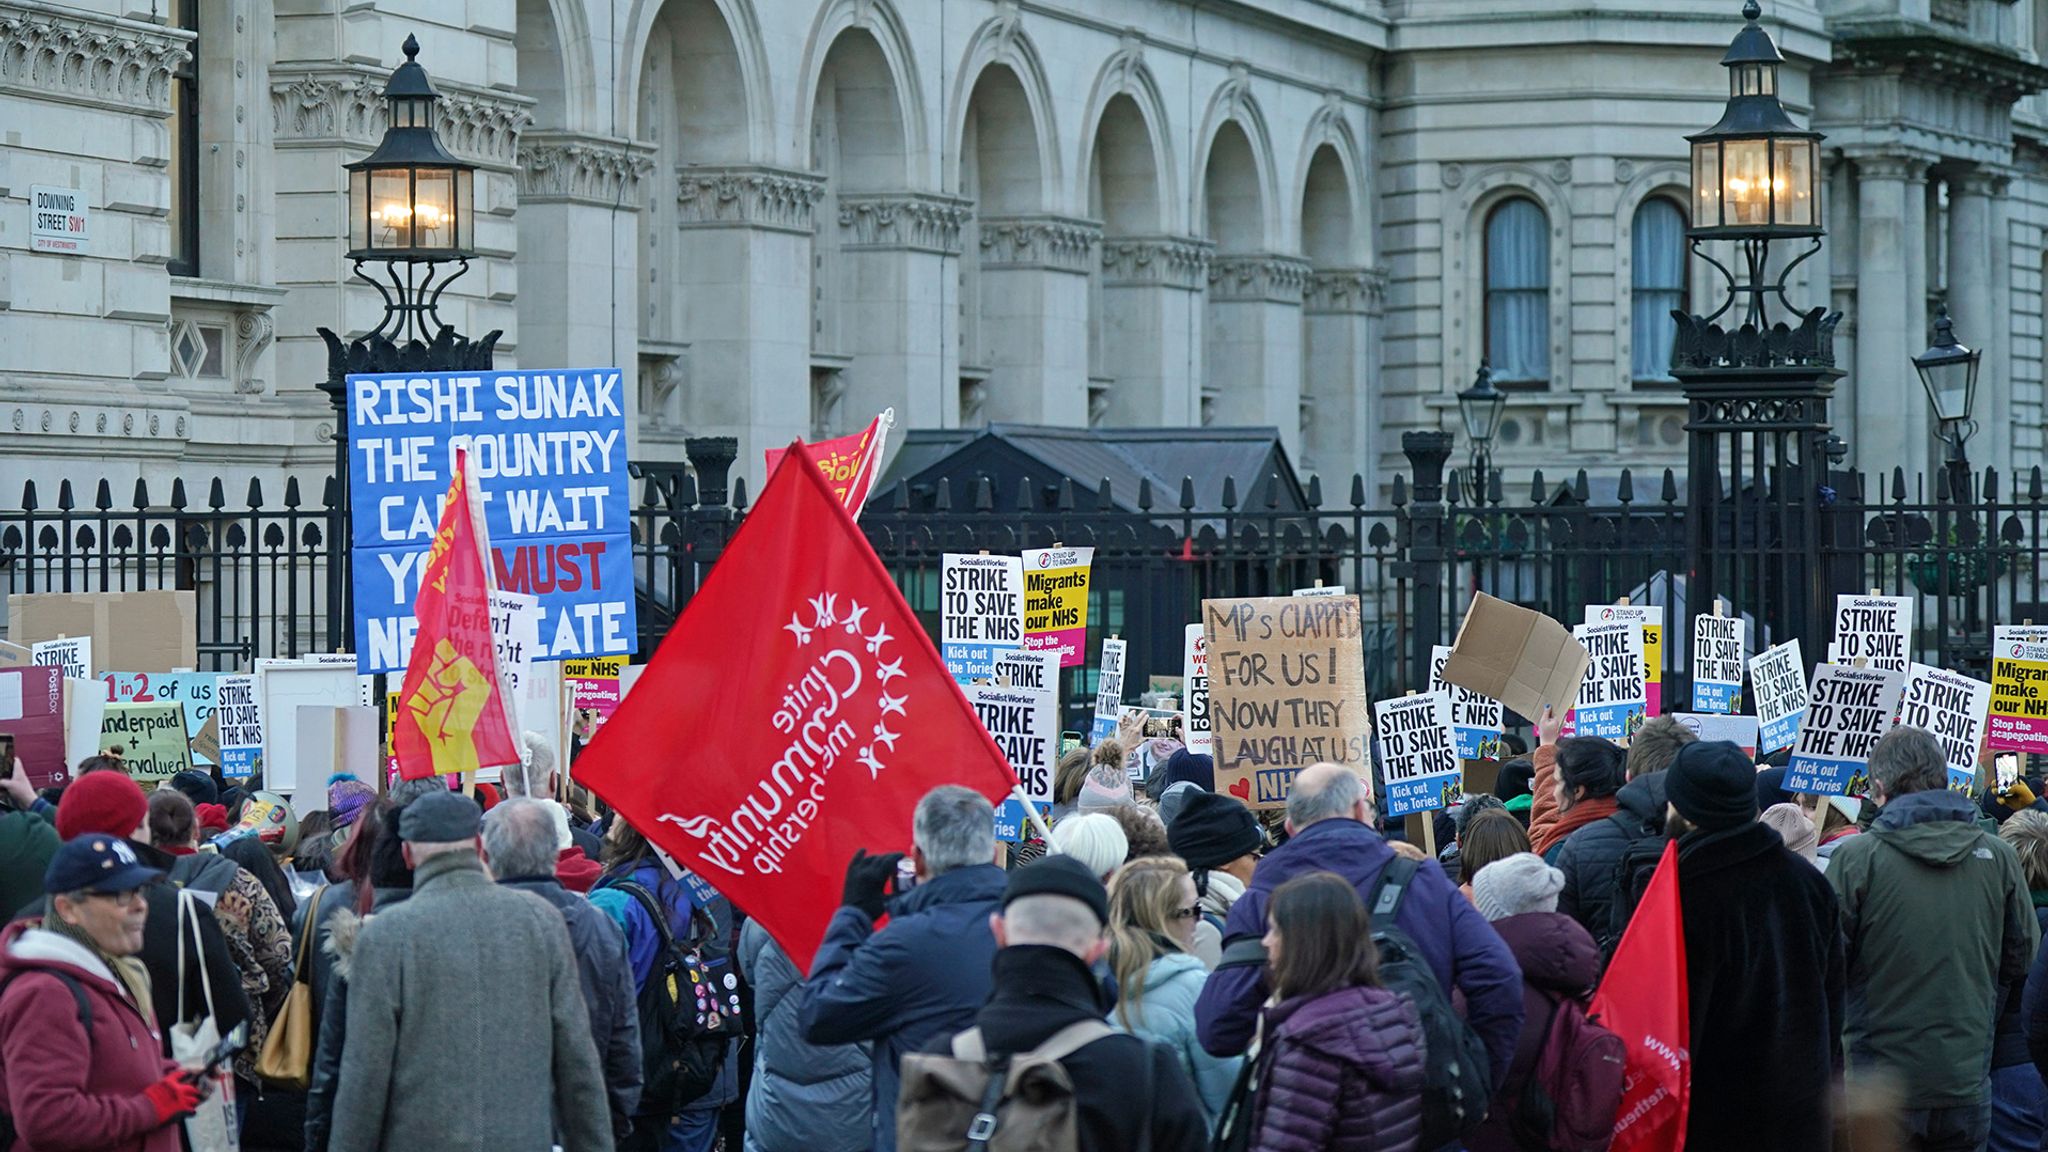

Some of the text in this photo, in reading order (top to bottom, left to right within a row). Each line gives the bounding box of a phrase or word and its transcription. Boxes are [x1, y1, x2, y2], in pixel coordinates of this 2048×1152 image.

[38, 192, 74, 212] DOWNING
[38, 213, 85, 232] STREET SW1
[354, 374, 621, 426] RISHI SUNAK
[357, 436, 437, 484] THE
[506, 486, 609, 534] WAIT
[491, 541, 606, 595] MUST
[960, 558, 1008, 567] Socialist Worker
[946, 567, 1008, 592] STRIKE
[1027, 571, 1086, 594] Migrants
[946, 592, 1017, 616] TO SAVE
[1026, 595, 1063, 612] make
[1876, 600, 1897, 608] Worker
[946, 616, 1020, 641] THE NHS
[1026, 608, 1078, 630] our NHS
[1608, 624, 1628, 632] Worker
[1698, 617, 1736, 640] STRIKE
[1840, 608, 1896, 633] STRIKE
[1024, 635, 1058, 648] Stop the
[1696, 638, 1740, 661] TO SAVE
[1838, 633, 1904, 658] TO SAVE
[35, 648, 78, 666] STRIKE
[948, 646, 988, 660] Kick out
[1006, 652, 1024, 661] Socialist
[565, 662, 620, 676] our NHS
[948, 661, 993, 674] the Tories
[995, 662, 1044, 688] STRIKE
[1220, 651, 1274, 687] FOR
[1601, 654, 1638, 678] SAVE
[1696, 659, 1741, 682] THE NHS
[1753, 654, 1792, 686] STRIKE
[1834, 670, 1886, 682] Socialist Worker
[1997, 662, 2048, 682] Migran
[104, 673, 212, 702] 1 in 2 of us
[584, 681, 598, 690] the
[1580, 677, 1641, 704] THE NHS
[1696, 684, 1723, 698] Kick out
[1756, 670, 1801, 704] TO SAVE
[1928, 670, 1975, 691] Socialist Worker
[1995, 683, 2038, 698] make
[219, 686, 252, 706] STRIKE
[576, 690, 618, 702] pegoating
[978, 691, 1036, 704] Socialist Worker
[1390, 697, 1434, 710] Socialist Worker
[1813, 678, 1883, 708] STRIKE
[1910, 678, 1974, 716] STRIKE
[1696, 698, 1728, 710] the Tories
[1758, 688, 1806, 724] THE NHS
[1994, 698, 2048, 716] our NH
[220, 706, 259, 726] TO SAVE
[969, 701, 1034, 735] TRIKE
[1214, 698, 1280, 732] NOW
[1284, 698, 1345, 728] THEY
[1380, 705, 1438, 735] STRIKE
[1466, 704, 1498, 727] NHS
[1580, 709, 1614, 724] Kick out
[1808, 704, 1886, 734] TO SAVE
[1906, 701, 1978, 744] TO SAVE
[1992, 718, 2032, 731] Stop the
[221, 726, 240, 746] THE
[242, 725, 262, 744] NHS
[1580, 723, 1622, 736] the Tories
[1764, 724, 1778, 737] Kick
[1778, 720, 1790, 732] out
[1382, 726, 1450, 758] TO SAVE
[1766, 730, 1797, 750] the Tories
[1800, 729, 1881, 759] THE NHS
[224, 751, 246, 762] Kick out
[1214, 735, 1297, 771] LAUGH
[1301, 736, 1326, 763] AT
[1942, 737, 1975, 768] NHS
[123, 752, 186, 775] ervalued
[224, 764, 252, 774] the Tories
[1386, 748, 1456, 780] THE NHS
[1794, 760, 1839, 777] Kick out
[1257, 769, 1301, 802] NH
[1392, 784, 1428, 797] Kick out
[1790, 774, 1842, 792] the Tories
[1394, 796, 1438, 813] the Tories
